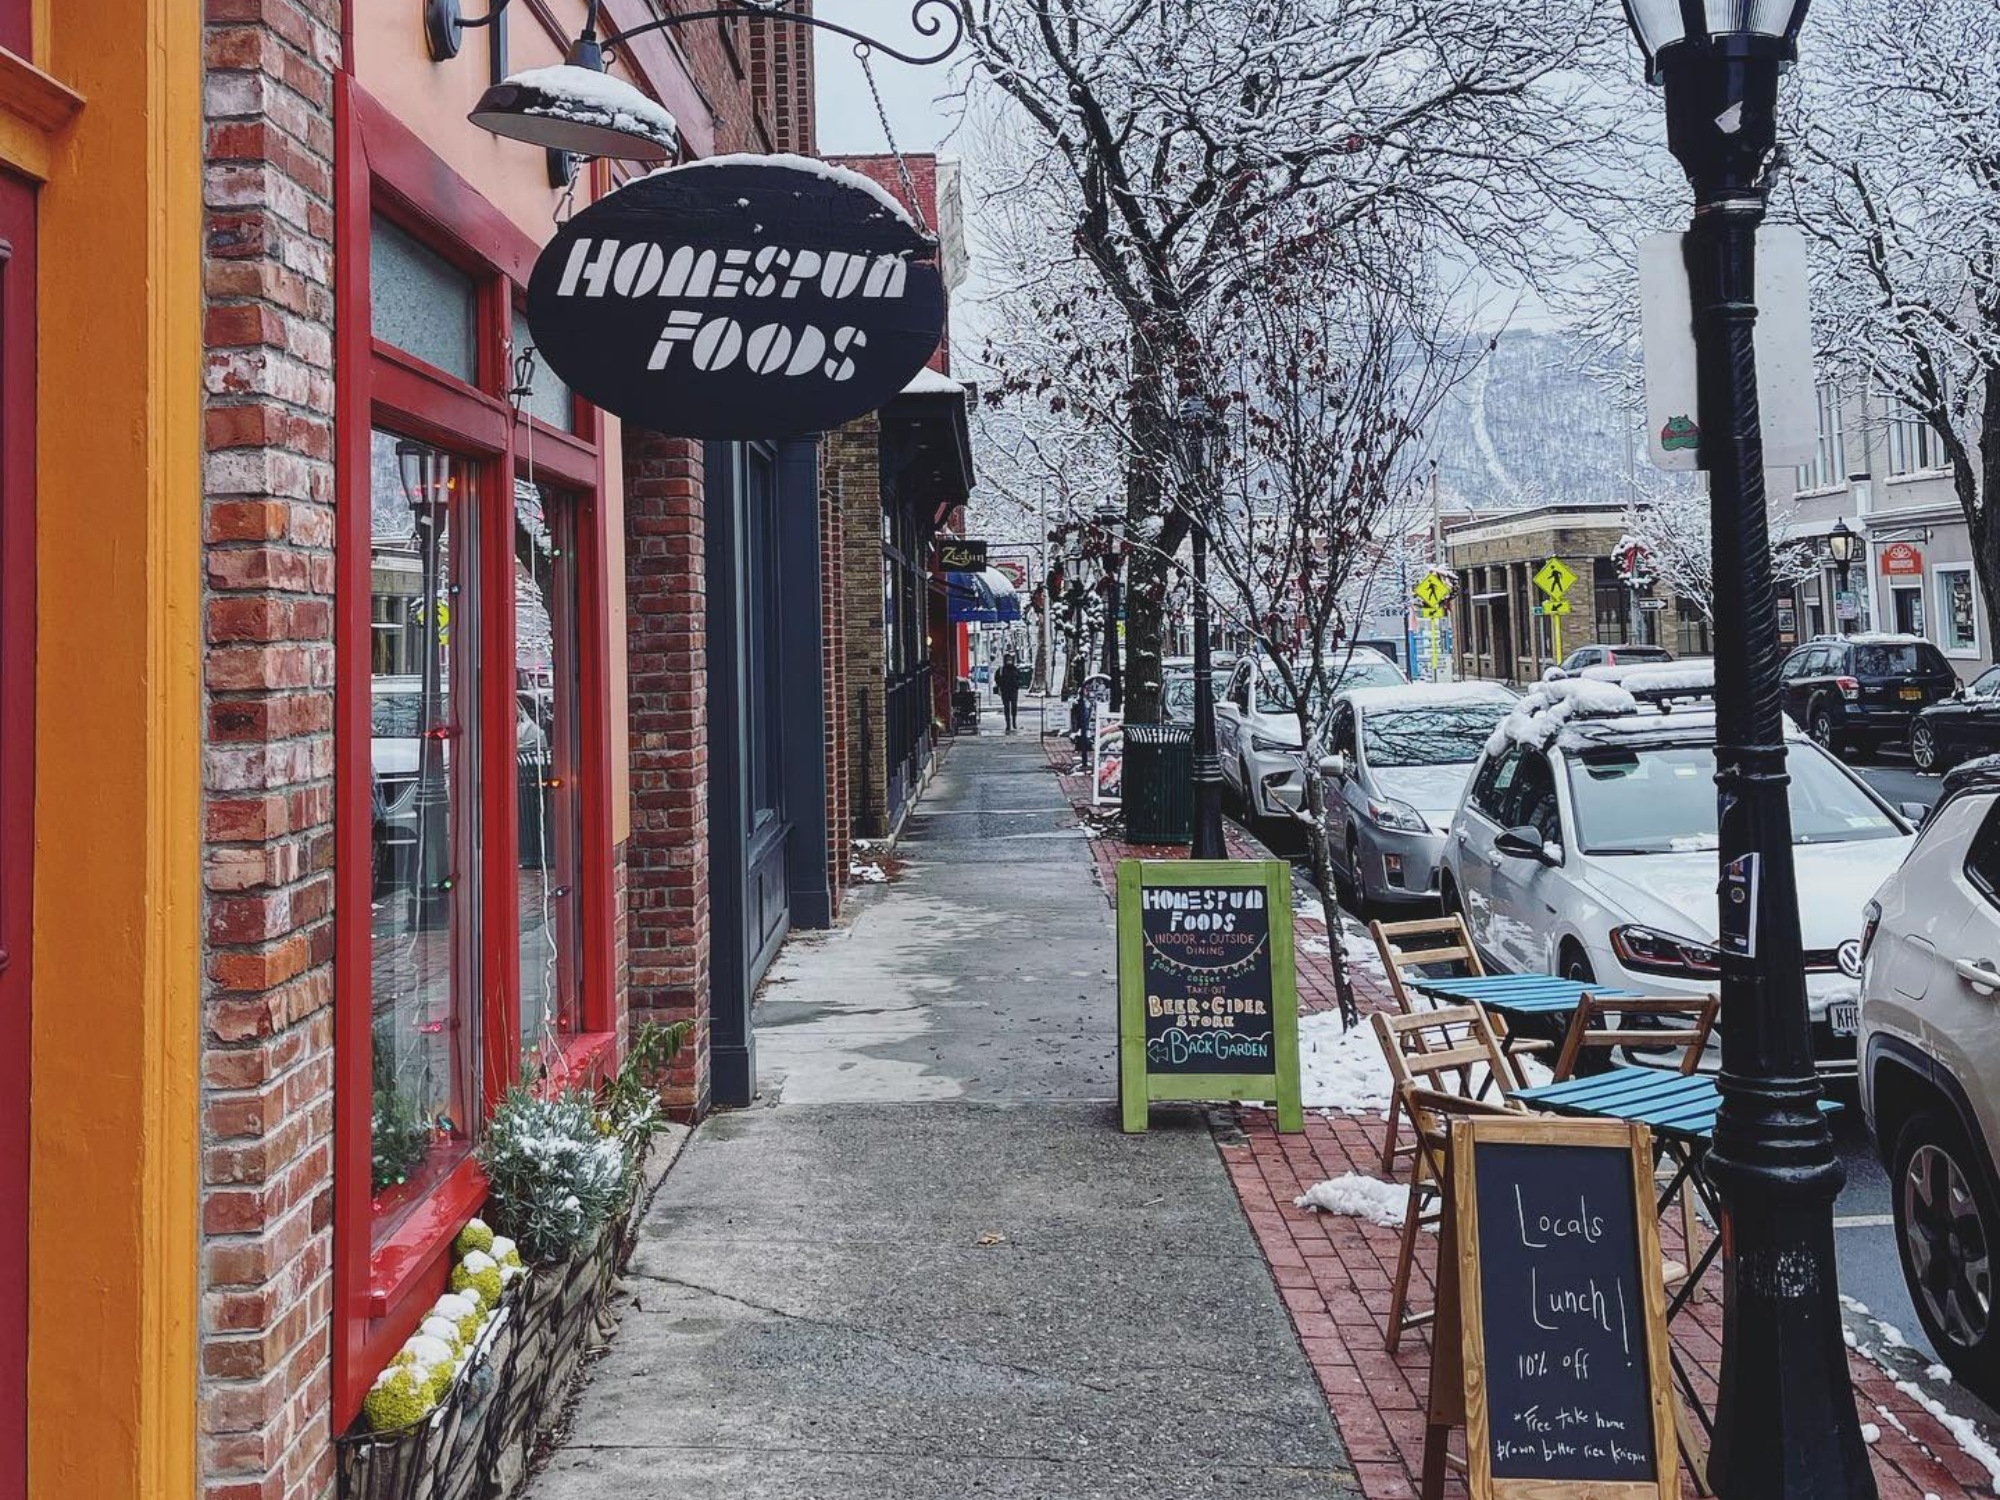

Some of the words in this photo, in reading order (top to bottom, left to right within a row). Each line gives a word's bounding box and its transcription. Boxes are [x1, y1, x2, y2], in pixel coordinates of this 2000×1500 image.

[557, 238, 908, 299] HOMESPUN
[647, 310, 867, 381] FOODS
[1142, 889, 1264, 911] HOMESPUN
[1170, 911, 1237, 932] FOODS
[1154, 932, 1197, 944] INDOOR
[1209, 932, 1255, 945] OUTSIDE
[1186, 946, 1225, 956] DINING
[1148, 995, 1201, 1017] BEER
[1211, 996, 1267, 1015] CIDER
[1176, 1015, 1235, 1028] STORE
[1171, 1031, 1213, 1063] BACK
[1215, 1031, 1268, 1059] GARDEN
[1514, 1183, 1604, 1248] Locals
[1519, 1350, 1548, 1380] 10%
[1563, 1348, 1590, 1380] off
[1555, 1406, 1589, 1430] take
